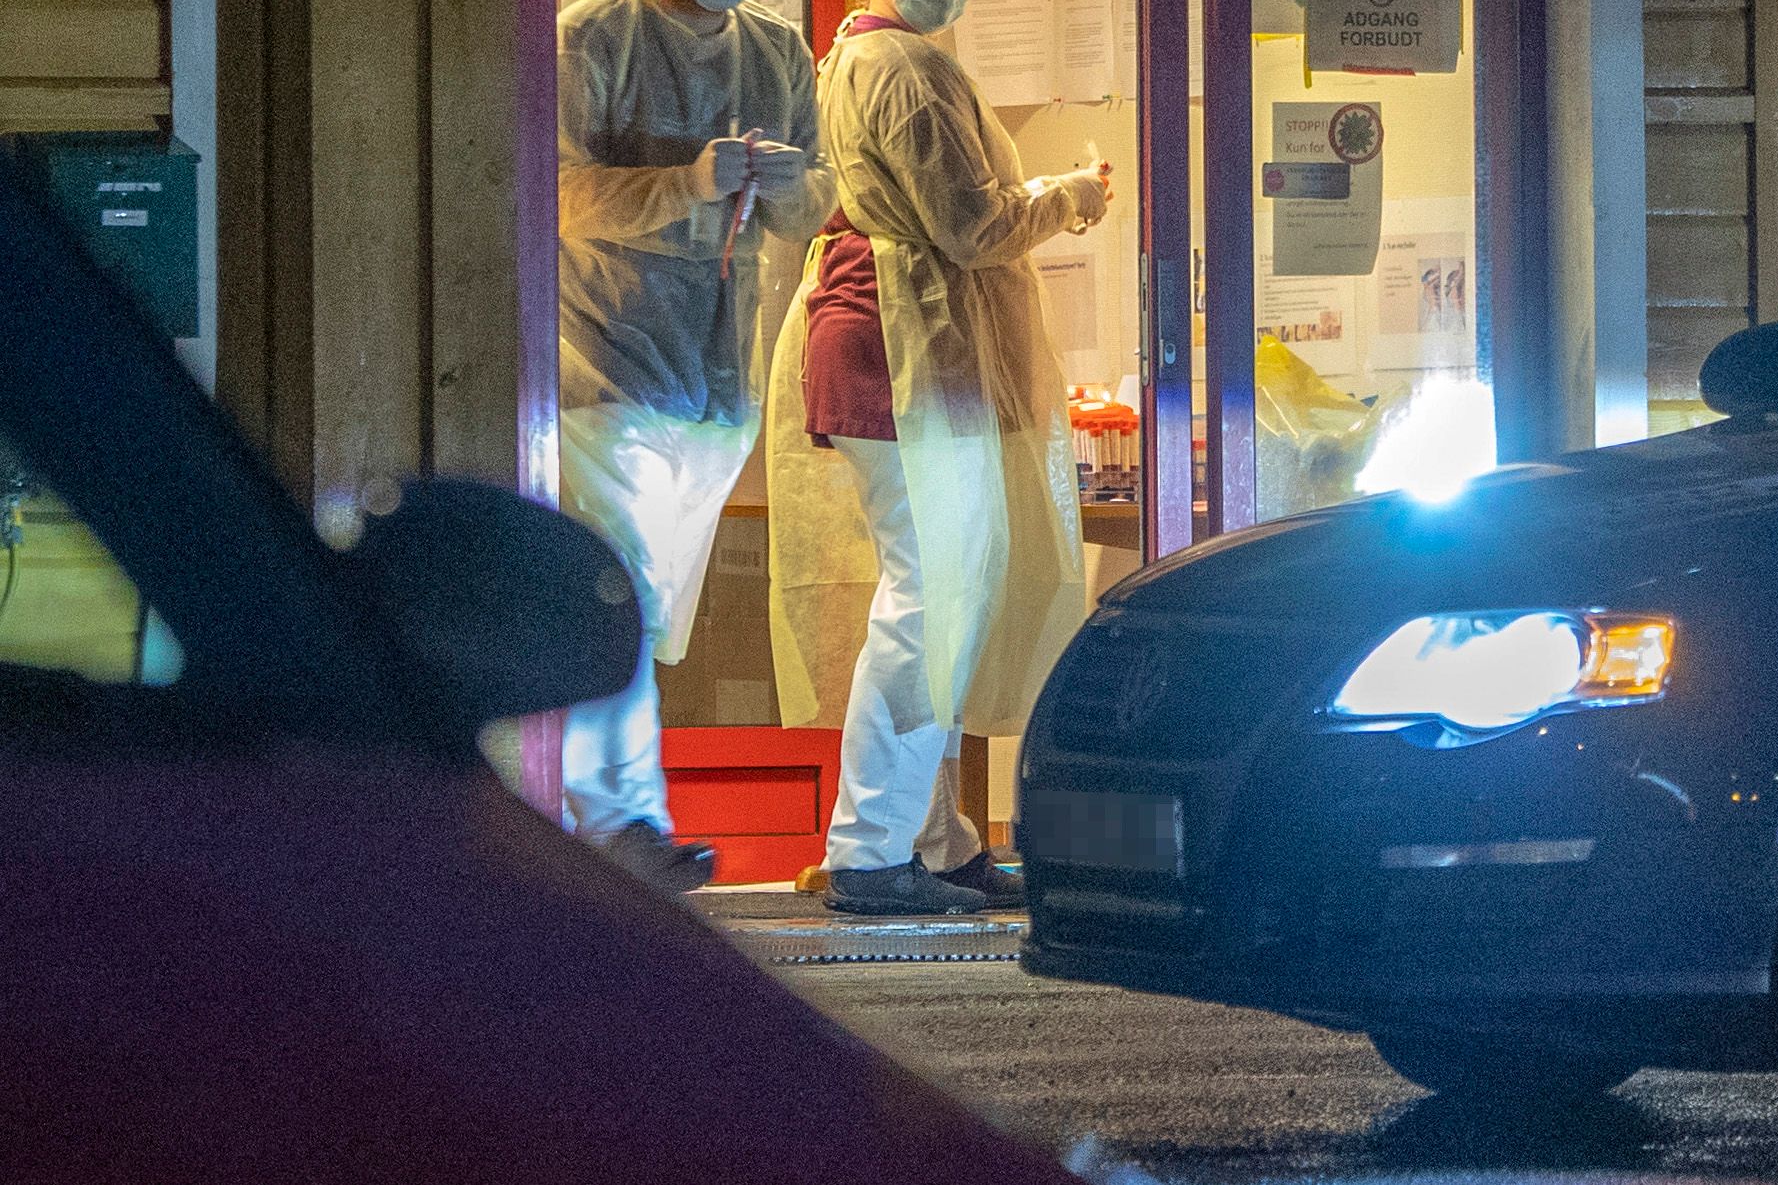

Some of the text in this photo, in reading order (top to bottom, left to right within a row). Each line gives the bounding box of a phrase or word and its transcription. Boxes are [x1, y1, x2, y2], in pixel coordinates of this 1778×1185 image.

[1342, 11, 1419, 27] ADGANG
[1340, 30, 1423, 47] FORBUDT
[1285, 140, 1325, 154] Kun for
